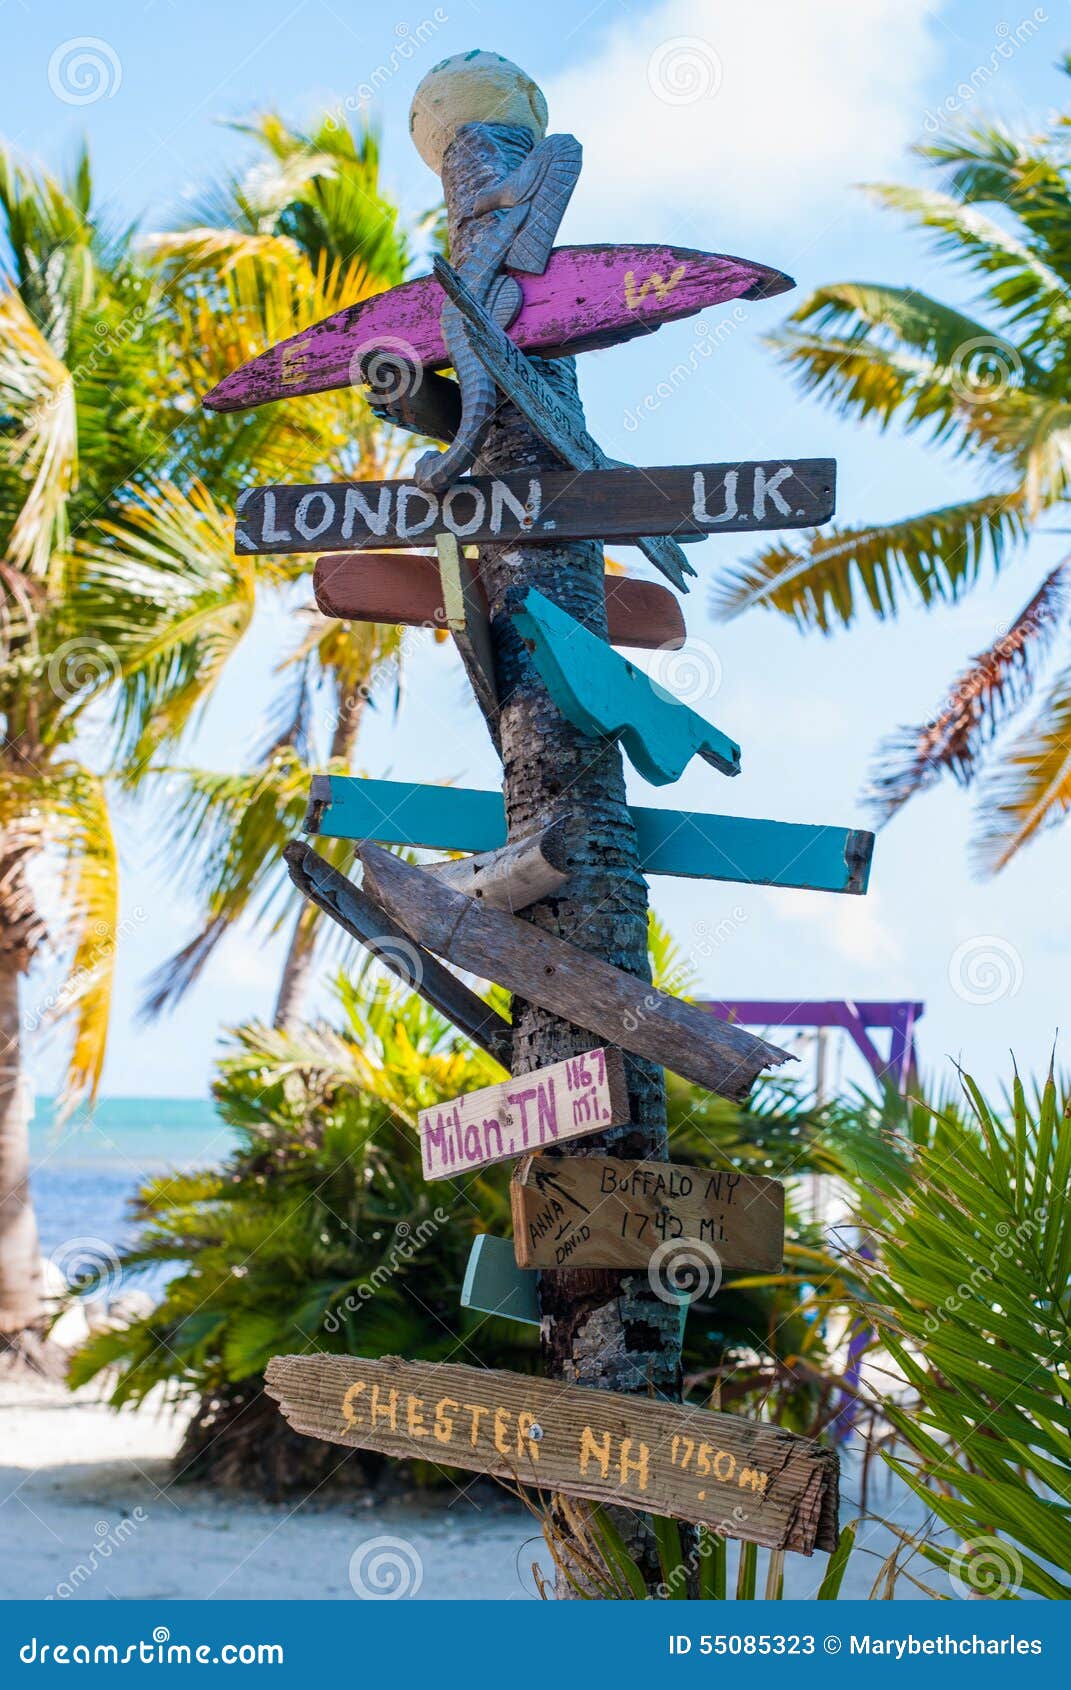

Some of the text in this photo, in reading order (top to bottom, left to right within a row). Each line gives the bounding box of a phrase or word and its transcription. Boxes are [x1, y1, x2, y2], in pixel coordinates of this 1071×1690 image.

[503, 336, 572, 437] Madison
[692, 466, 806, 523] U.K.
[529, 1198, 564, 1249] ANNA
[621, 1205, 684, 1241] 1742
[340, 1380, 541, 1461] CHESTER
[671, 1434, 737, 1482] 1750
